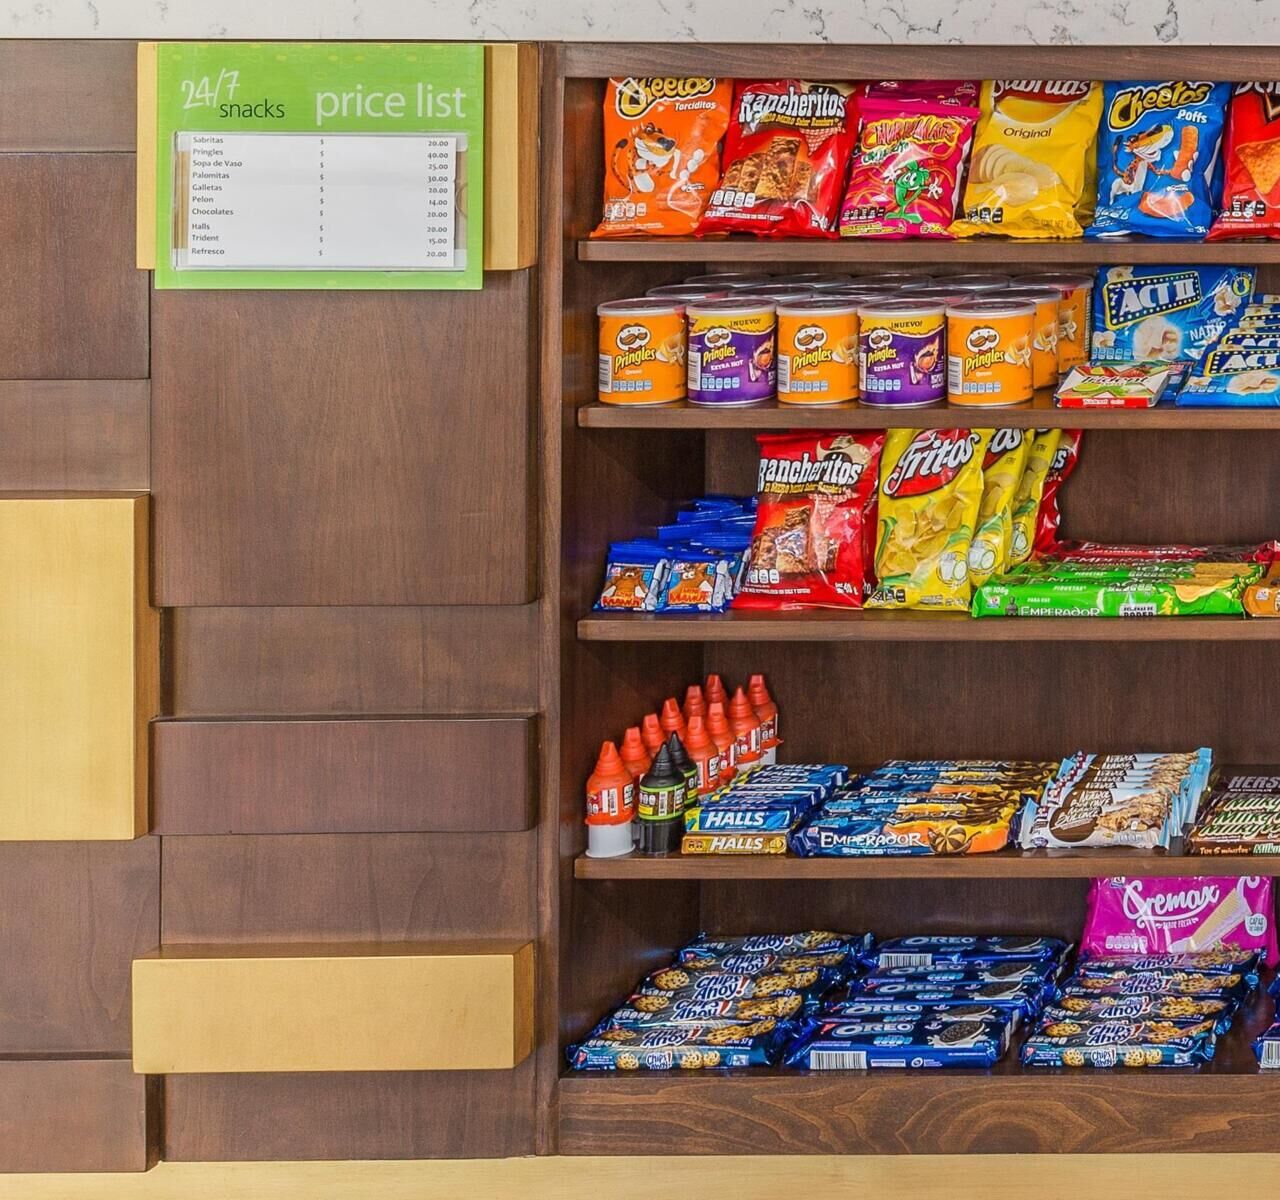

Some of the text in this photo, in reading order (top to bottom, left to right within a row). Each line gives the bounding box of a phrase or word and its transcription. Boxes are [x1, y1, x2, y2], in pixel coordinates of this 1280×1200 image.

[181, 67, 466, 126] 24/7 price list
[738, 86, 847, 123] Rancheritos
[1109, 81, 1212, 129] Cheetos
[220, 99, 285, 118] snacks
[675, 101, 717, 112] Torciditos
[1176, 109, 1208, 123] Poffs
[193, 136, 223, 144] Sabritas
[1003, 127, 1052, 139] Original
[193, 148, 223, 157] Pringles
[1119, 277, 1196, 316] ACT II
[614, 346, 656, 374] Pringles
[703, 344, 736, 367] Pringles
[793, 347, 832, 374] Pringles
[867, 347, 897, 367] Pringles
[964, 349, 1004, 376] Pringles
[1221, 351, 1279, 370] ACT
[883, 432, 980, 496] Fritos
[705, 812, 765, 827] HALLS
[710, 837, 763, 851] HALLS
[820, 832, 925, 848] EMPERADOR
[903, 936, 976, 945] OREO
[843, 1003, 921, 1014] OREO
[834, 1023, 913, 1035] OREO
